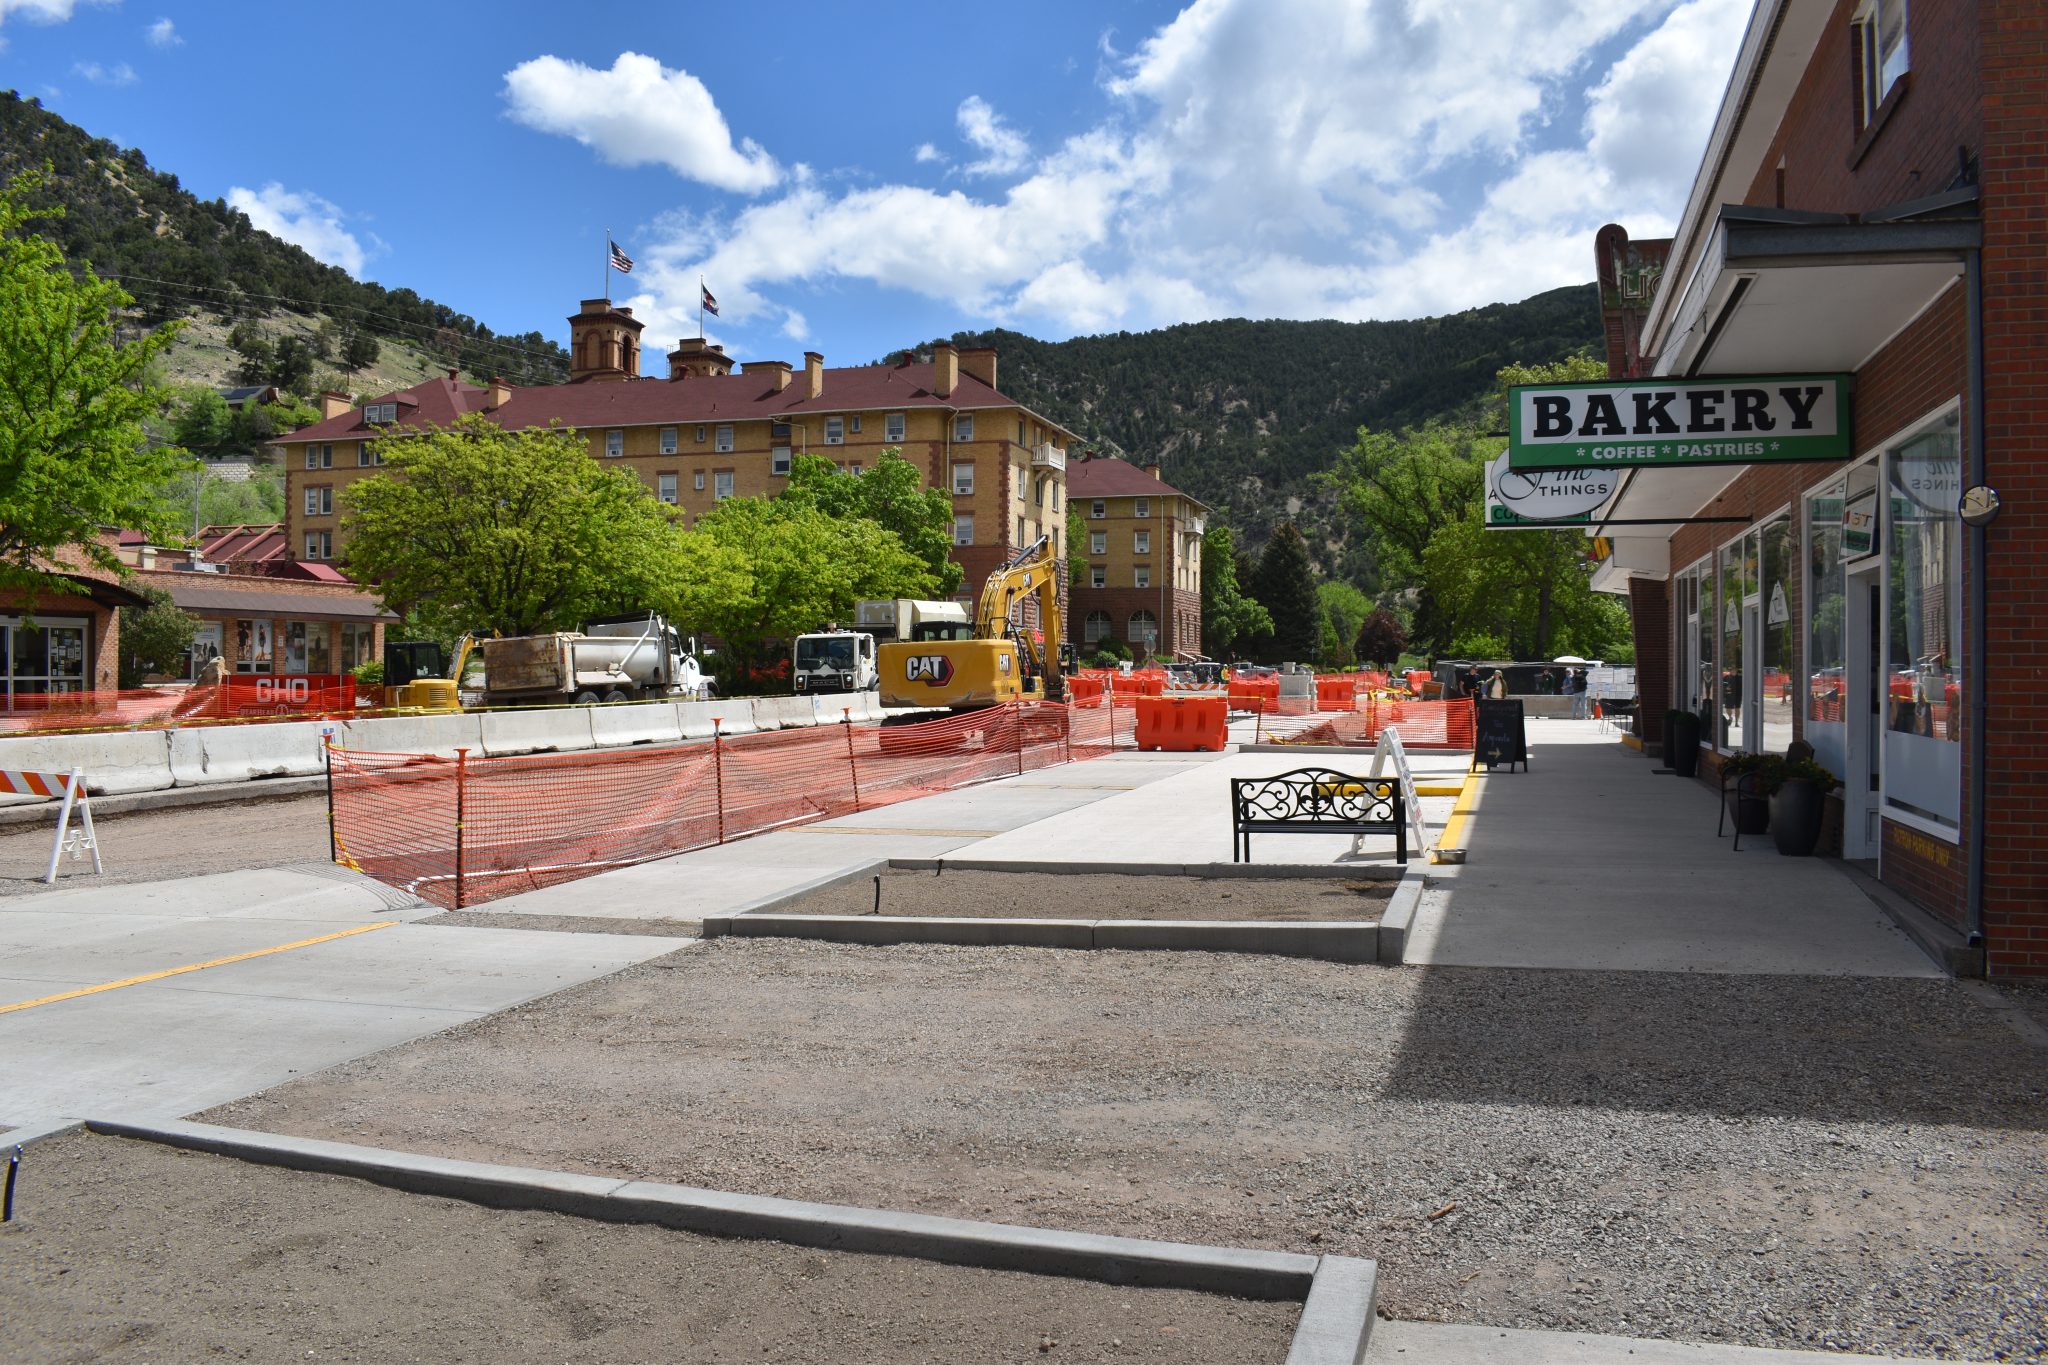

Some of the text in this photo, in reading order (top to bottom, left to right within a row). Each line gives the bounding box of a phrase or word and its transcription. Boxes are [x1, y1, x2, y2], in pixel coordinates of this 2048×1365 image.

[1533, 386, 1823, 438] BAKERY
[1591, 443, 1765, 459] COFFEE PASTRIES
[1539, 484, 1608, 497] THINGS
[906, 656, 942, 681] CAT
[256, 679, 308, 702] GHO
